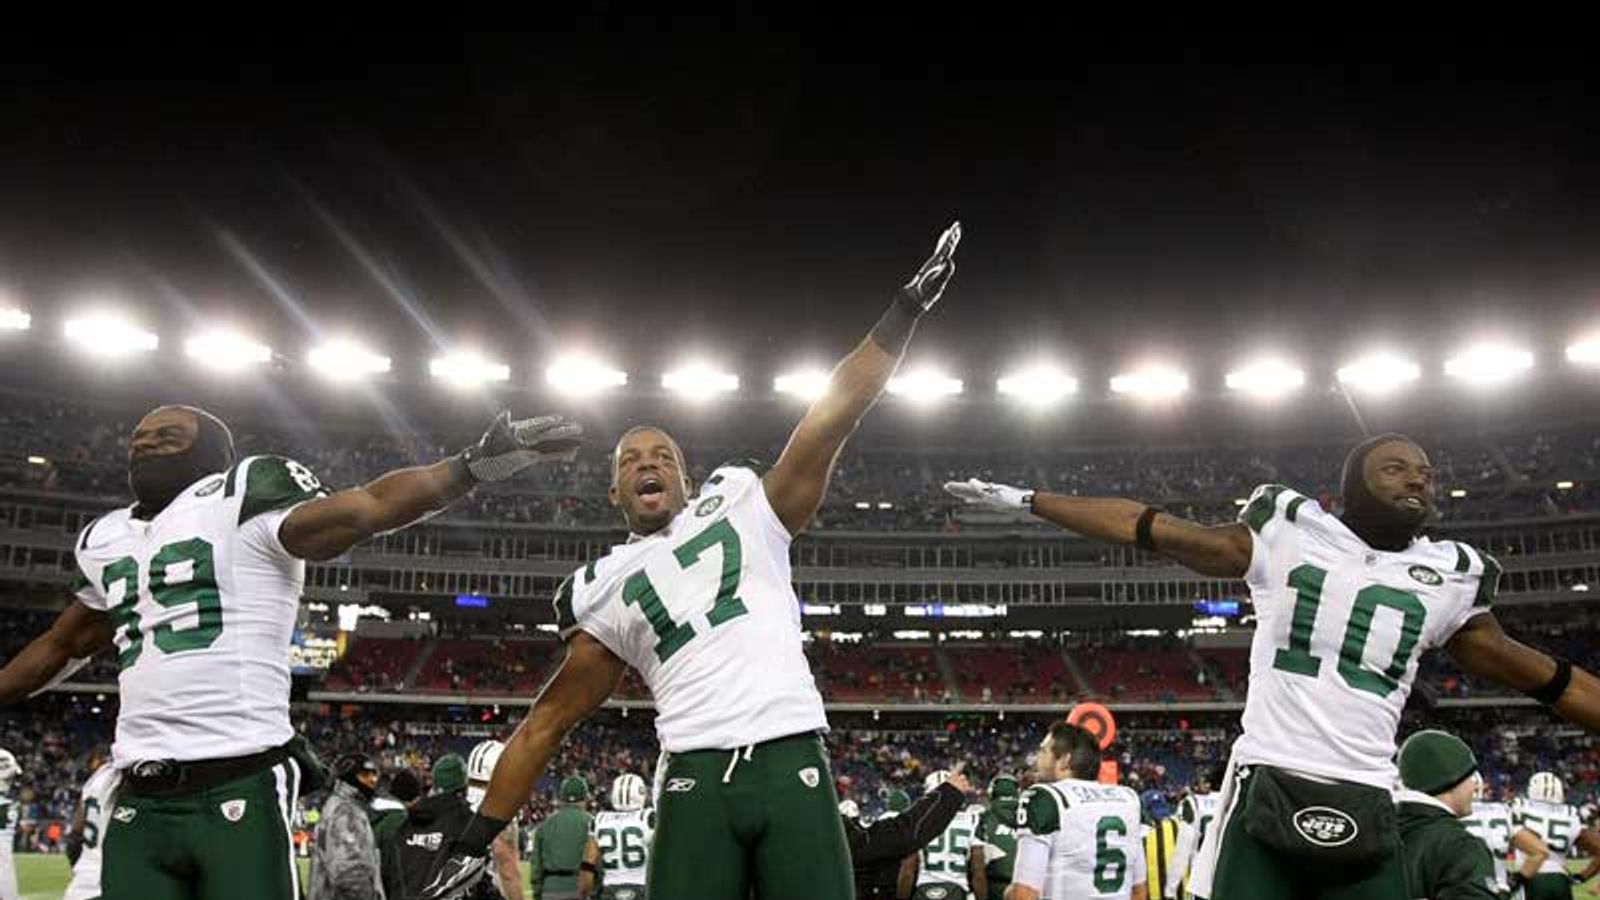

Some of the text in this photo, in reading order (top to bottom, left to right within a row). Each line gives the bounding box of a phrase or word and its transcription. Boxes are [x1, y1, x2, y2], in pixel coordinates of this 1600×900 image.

[621, 516, 749, 665] 17
[1271, 562, 1428, 699] 10
[597, 826, 646, 870] 26
[1092, 815, 1128, 894] 6
